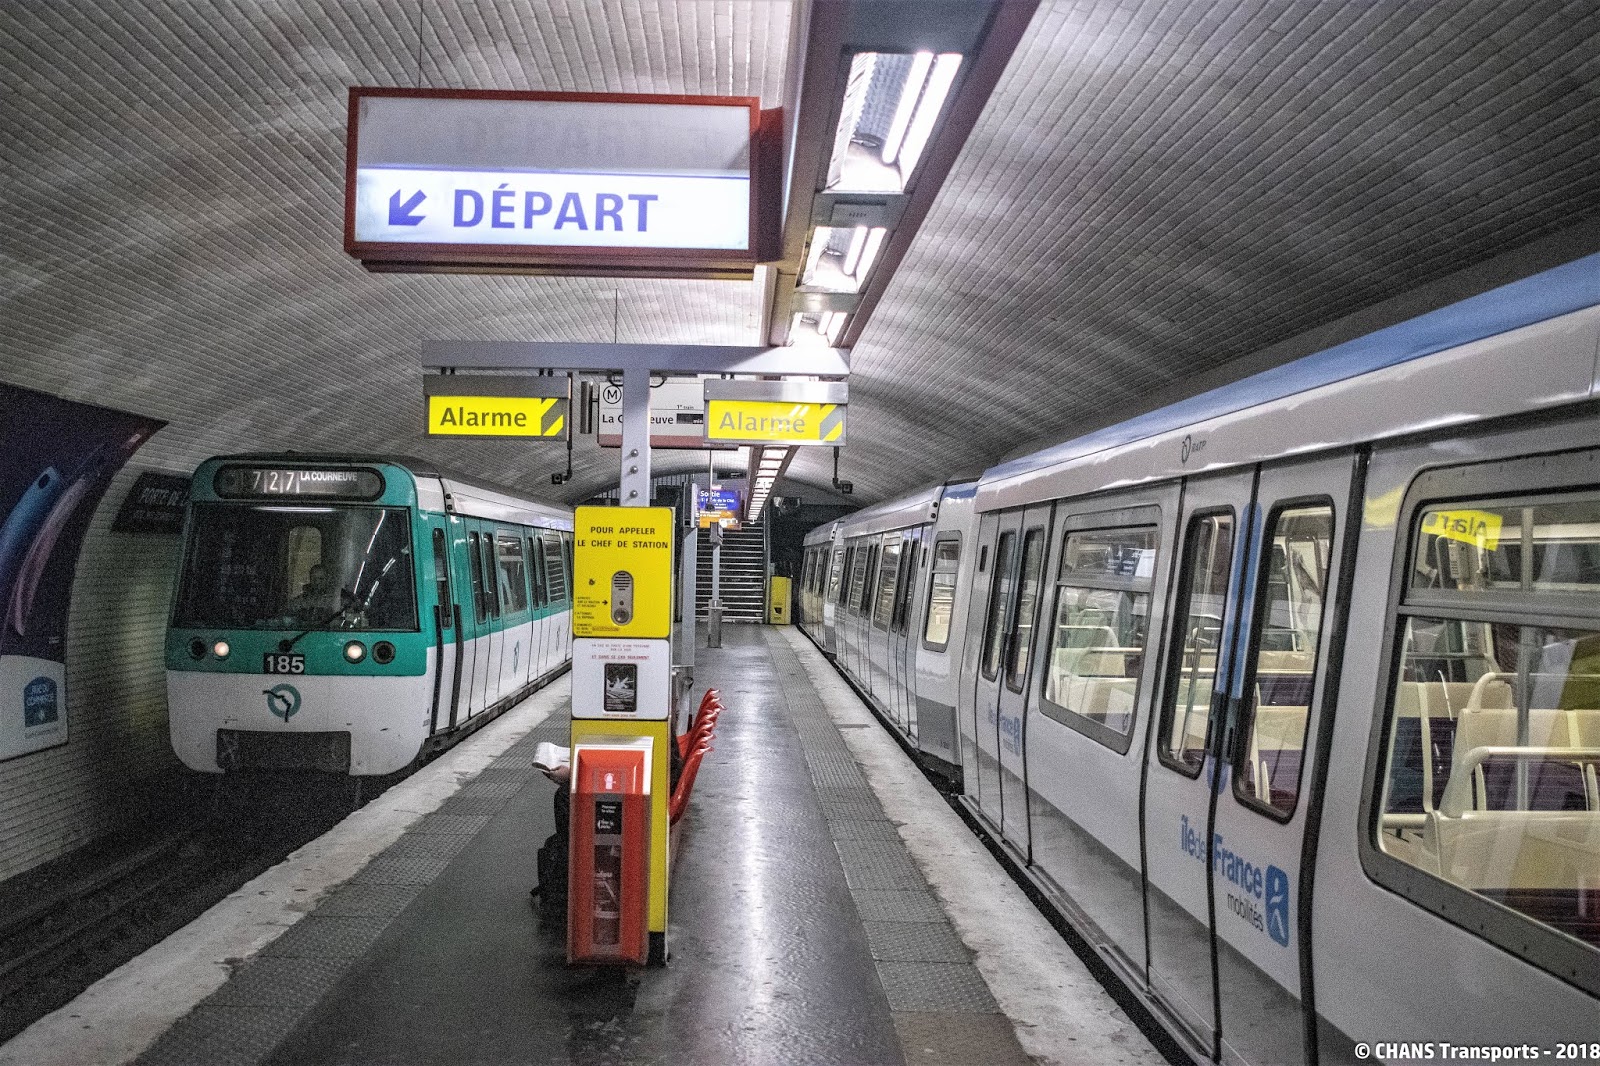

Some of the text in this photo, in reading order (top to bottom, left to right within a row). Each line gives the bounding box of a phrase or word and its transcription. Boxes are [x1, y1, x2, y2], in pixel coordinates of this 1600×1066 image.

[453, 183, 659, 232] DÉPART
[606, 389, 618, 400] M
[440, 406, 527, 427] Alarme
[602, 414, 614, 424] La
[719, 411, 806, 433] Alarme
[300, 471, 310, 481] LA
[311, 471, 357, 482] COURNEUVE
[700, 490, 720, 498] Sotie
[590, 526, 656, 535] POUR APPELER
[577, 539, 668, 549] LE CHEF DE STATION
[266, 655, 305, 674] 185
[1212, 832, 1263, 900] France
[1227, 893, 1264, 933] mobilités
